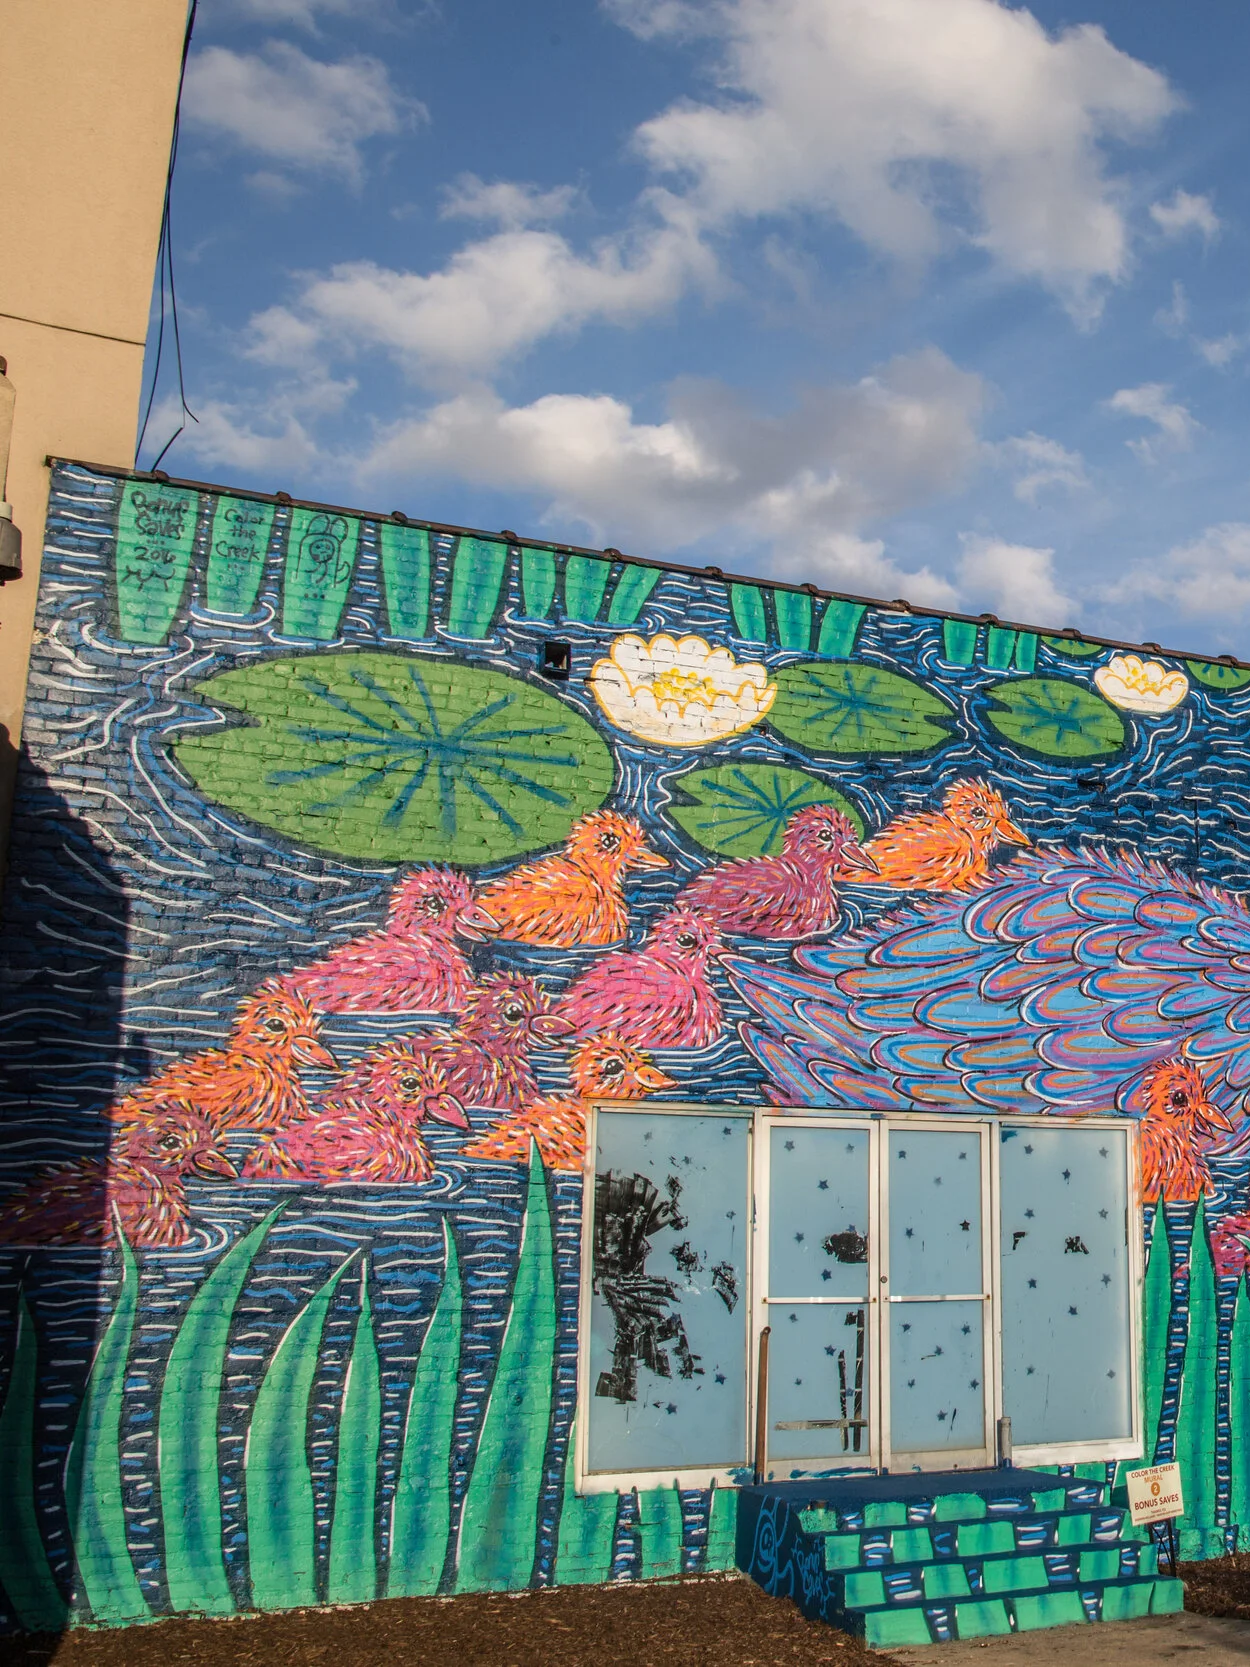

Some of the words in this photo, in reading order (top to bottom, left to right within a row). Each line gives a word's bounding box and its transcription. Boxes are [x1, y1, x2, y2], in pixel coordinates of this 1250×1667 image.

[225, 508, 265, 525] Color
[229, 525, 257, 540] the
[134, 546, 176, 565] 2016
[216, 541, 260, 562] Creek
[1131, 1470, 1148, 1478] COLOR
[1144, 1474, 1163, 1482] MURAL
[1135, 1499, 1158, 1510] BONUS
[1160, 1494, 1178, 1505] SAVES
